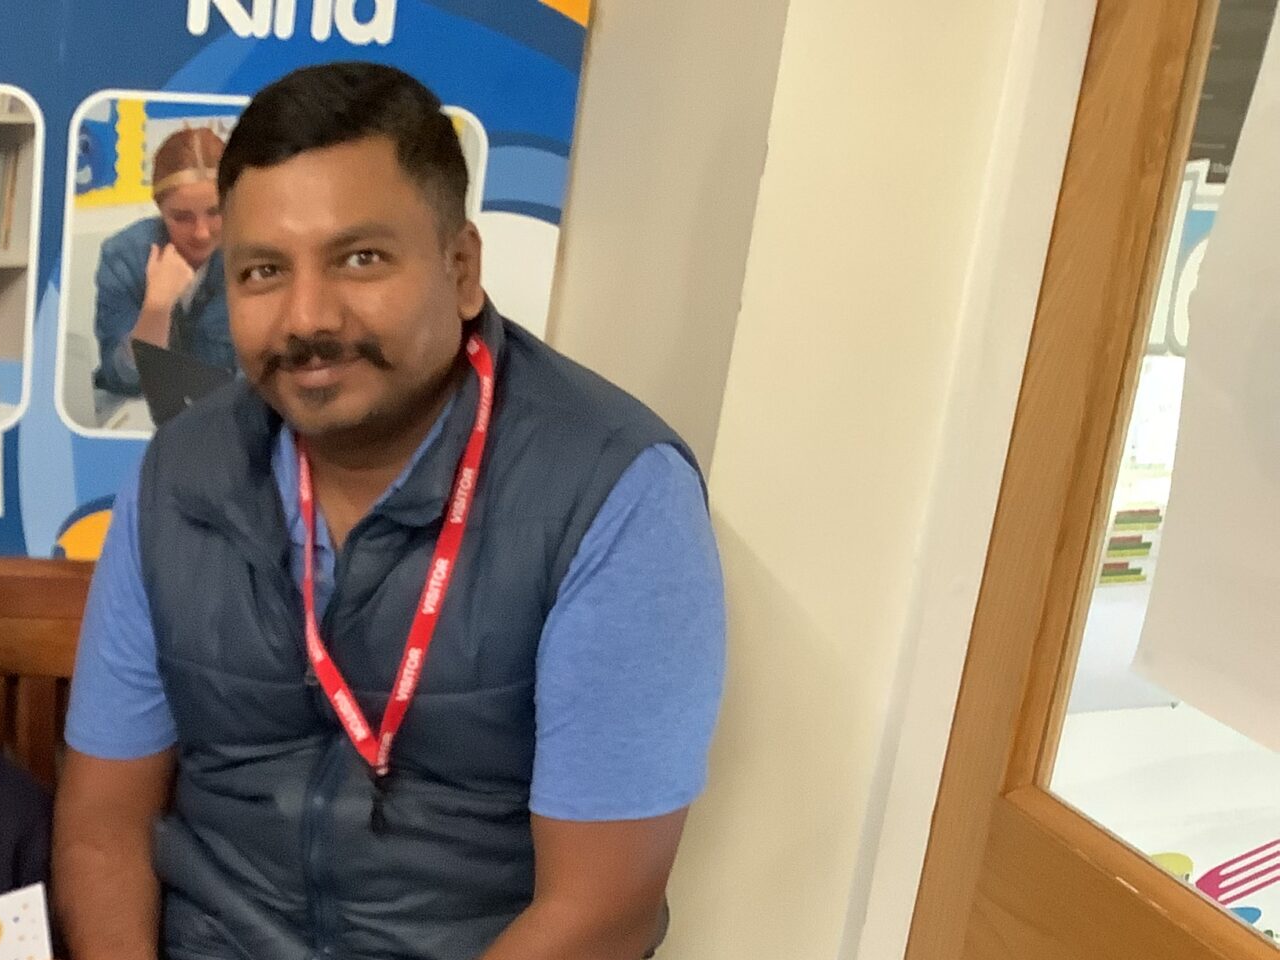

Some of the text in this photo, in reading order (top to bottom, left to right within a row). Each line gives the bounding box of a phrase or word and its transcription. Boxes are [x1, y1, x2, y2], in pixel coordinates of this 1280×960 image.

[450, 467, 474, 524] VISITOR
[422, 558, 450, 615] VISITOR
[396, 647, 423, 701] VISITOR
